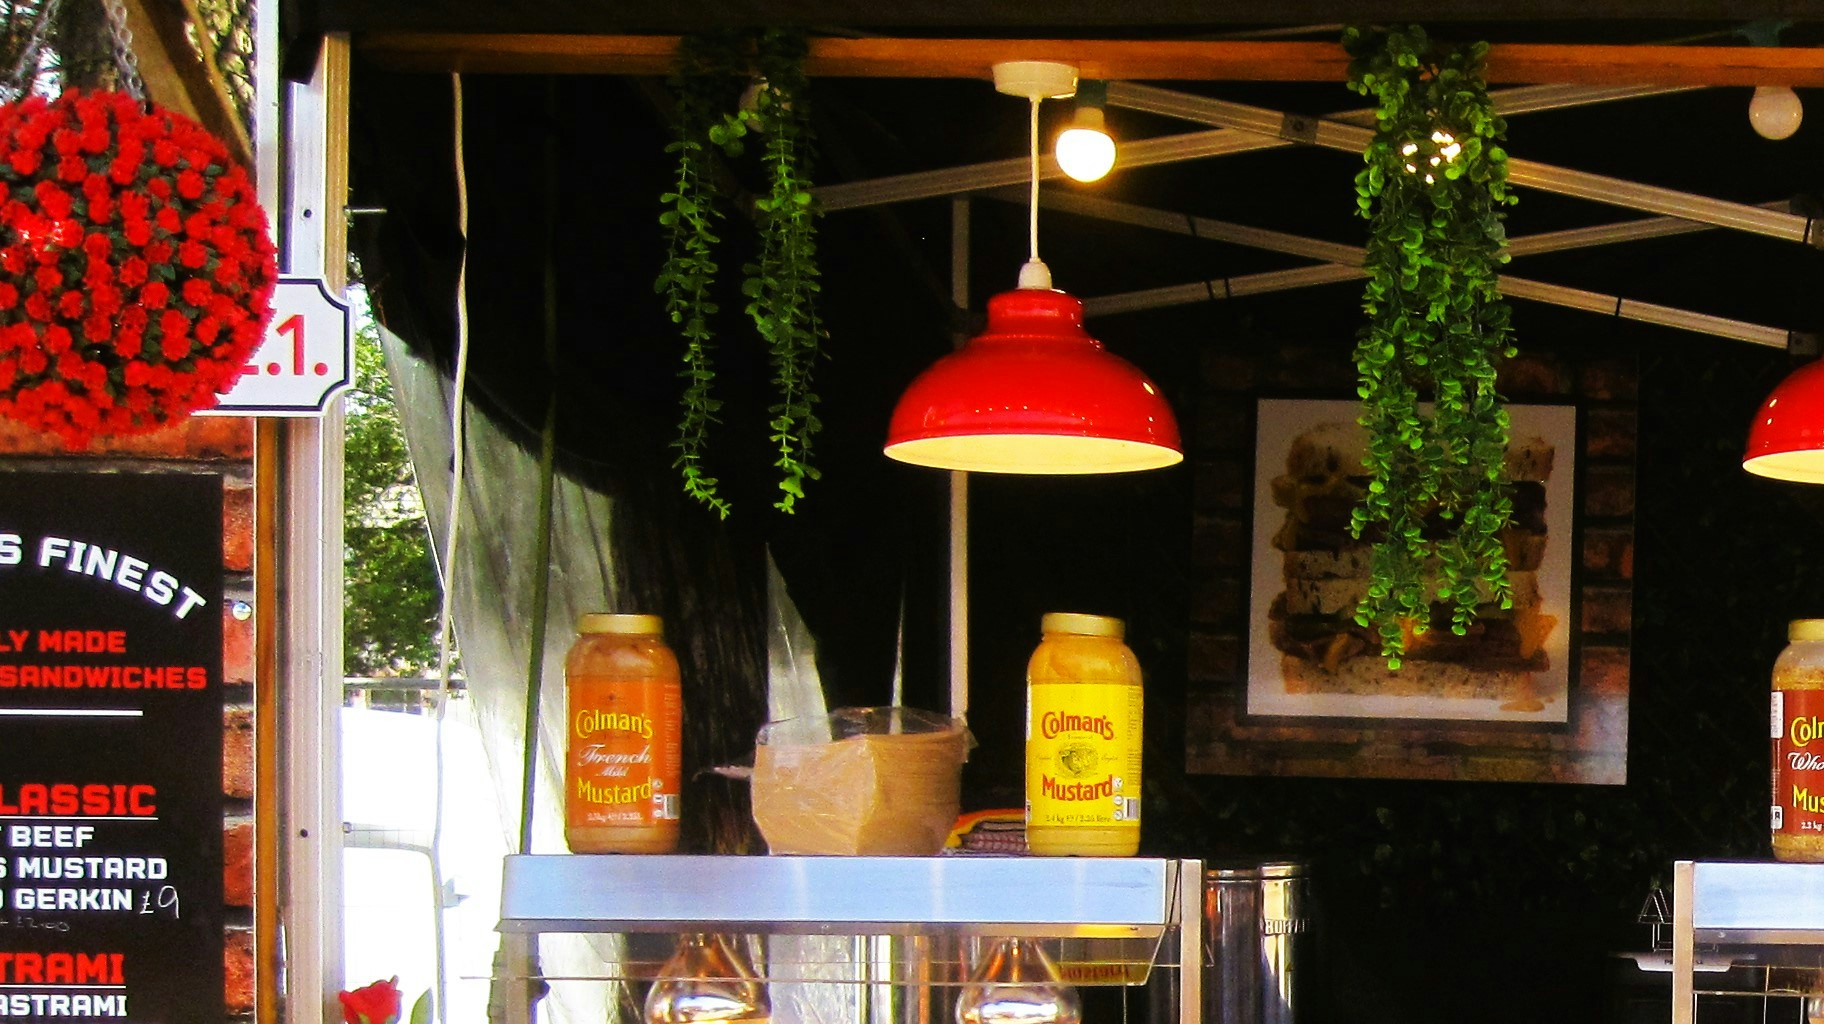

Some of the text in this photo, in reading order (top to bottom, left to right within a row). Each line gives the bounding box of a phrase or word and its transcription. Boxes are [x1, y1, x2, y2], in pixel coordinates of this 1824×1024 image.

[244, 314, 328, 376] .1.
[39, 535, 207, 621] FINEST
[38, 630, 126, 653] MADE
[0, 666, 208, 690] SANDWICHES
[576, 709, 653, 740] Colman's
[1041, 710, 1115, 740] Colman's
[577, 744, 653, 767] French
[578, 776, 652, 804] Mustard
[1041, 774, 1113, 801] Mustard
[11, 826, 94, 848] BEEF
[18, 857, 168, 880] MUSTARD
[15, 888, 133, 911] GERKIN
[139, 885, 180, 919] £9
